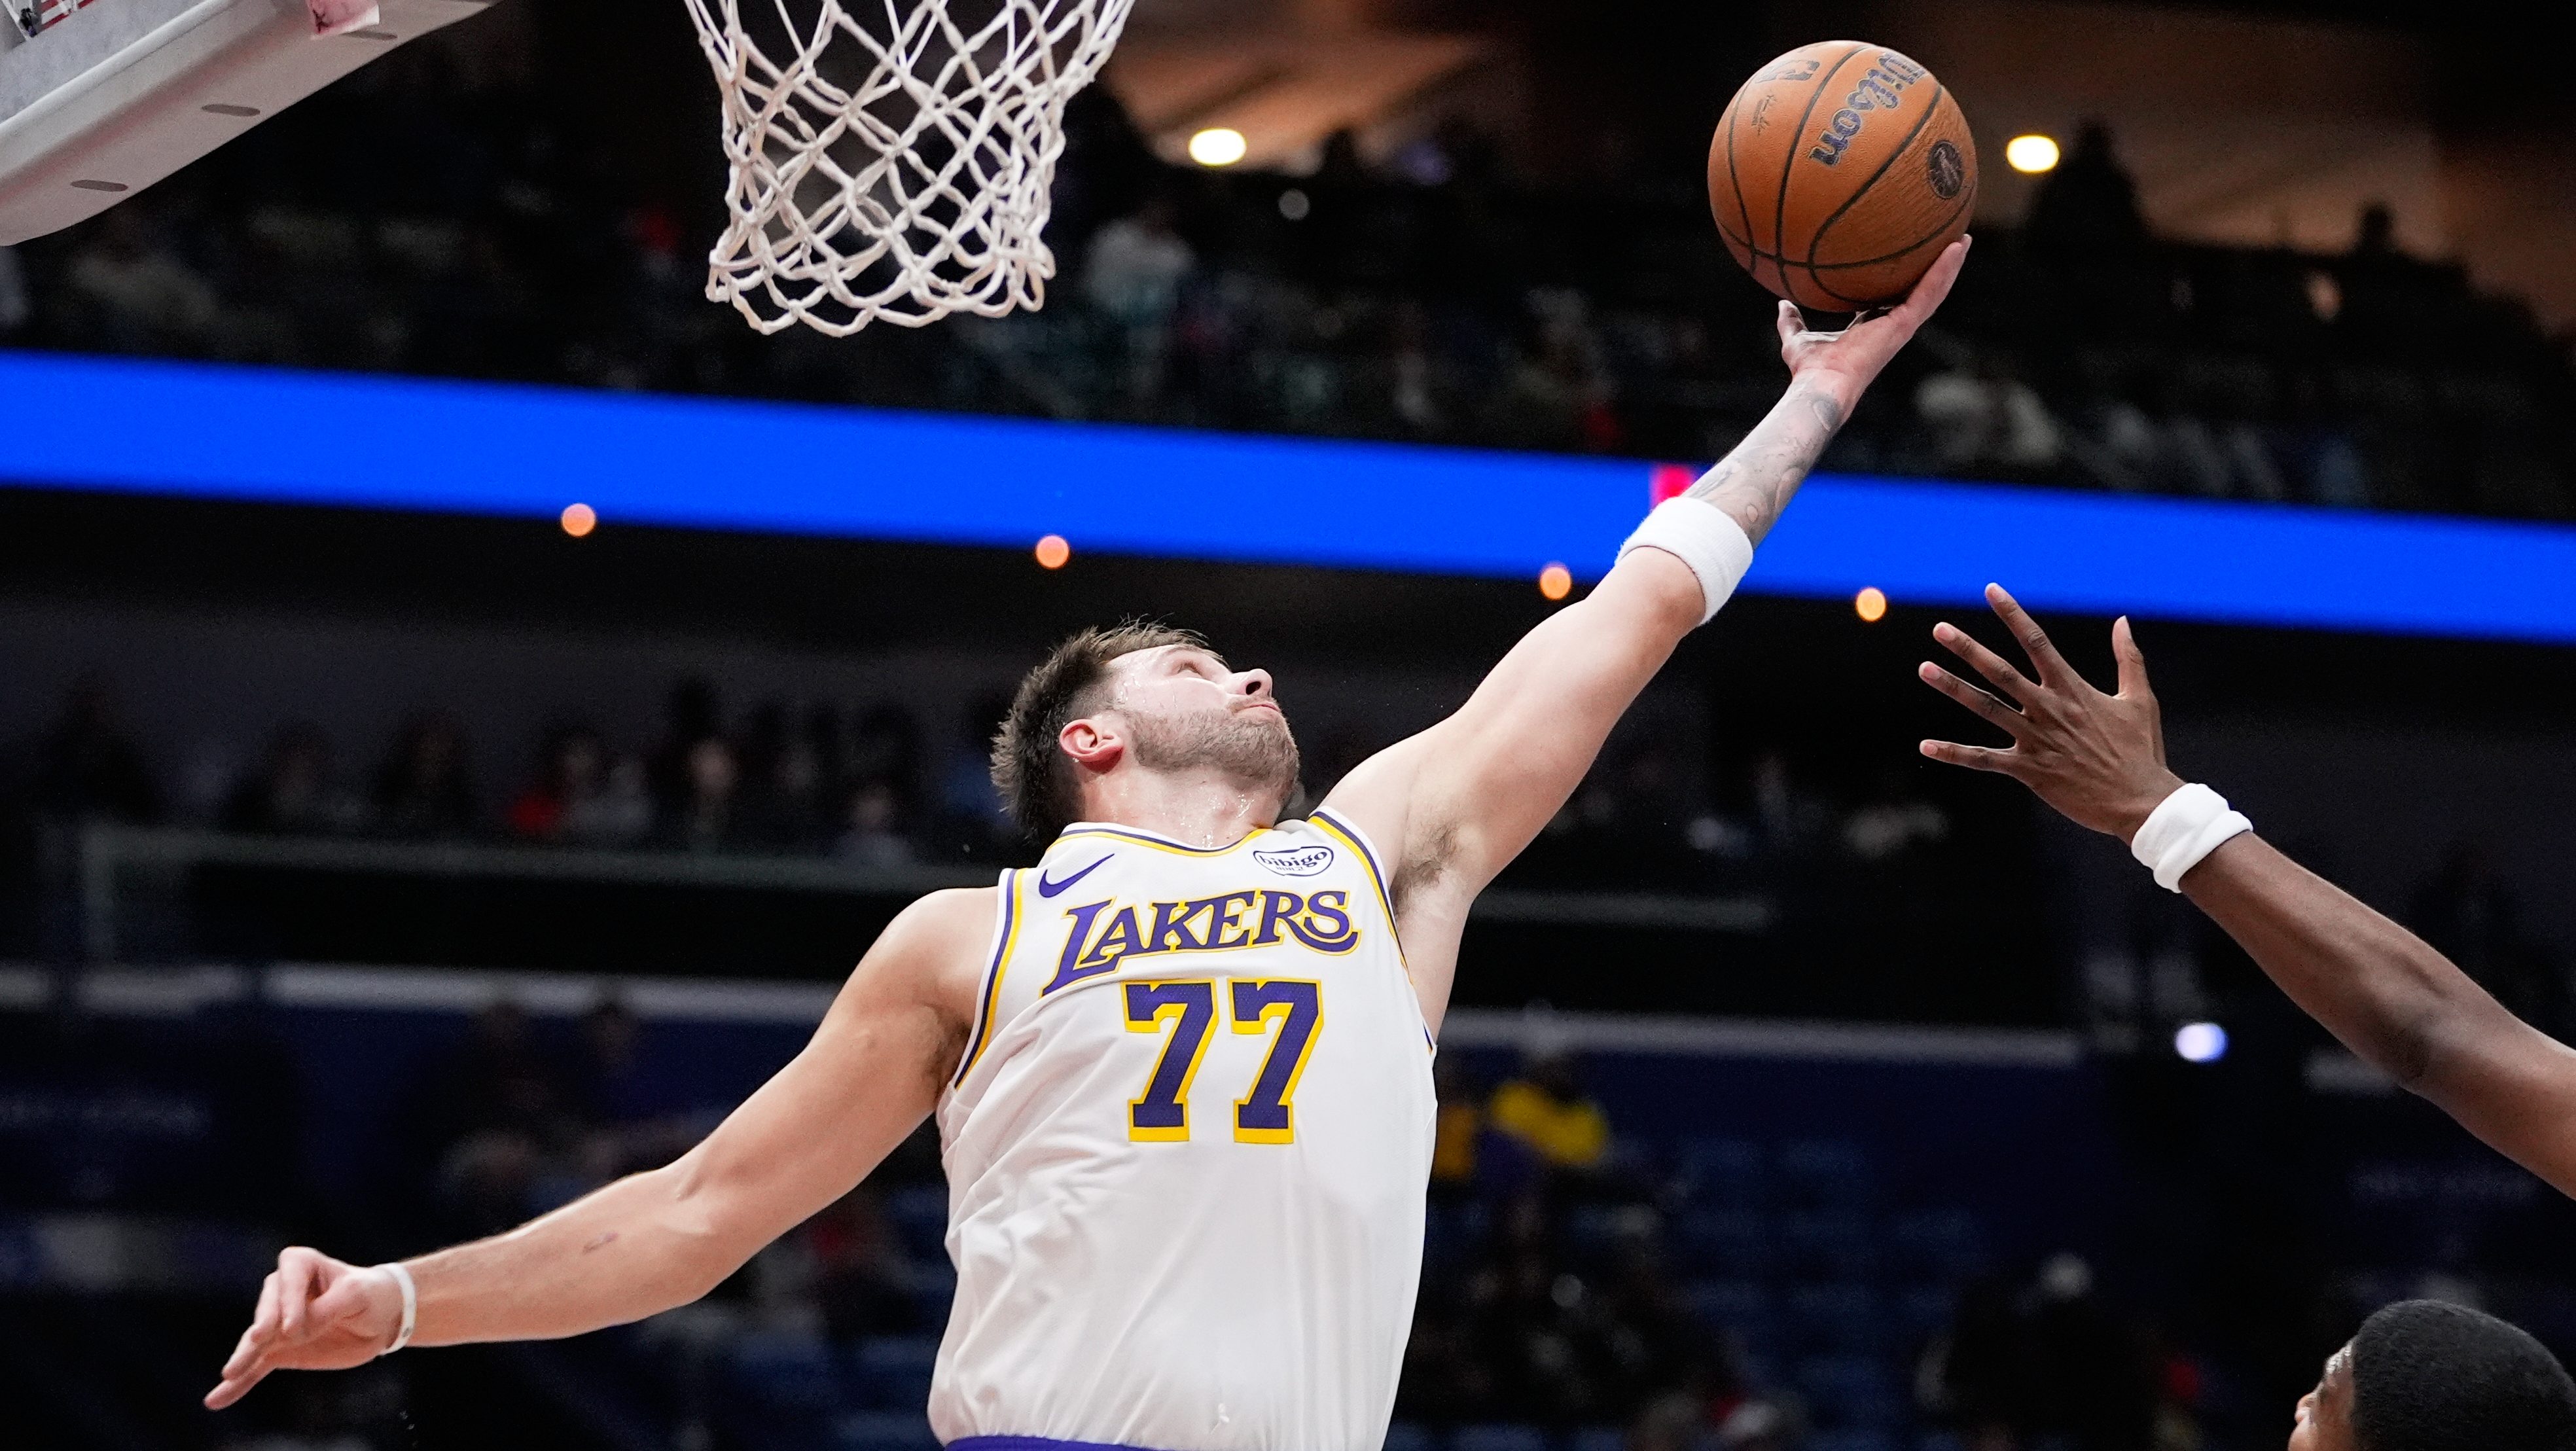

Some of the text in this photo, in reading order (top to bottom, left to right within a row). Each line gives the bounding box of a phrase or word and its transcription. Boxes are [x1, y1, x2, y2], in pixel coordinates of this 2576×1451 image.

[1809, 52, 1925, 166] Wilson
[1259, 851, 1327, 868] bibigo
[1041, 889, 1361, 997] LAKERS
[1121, 978, 1324, 1143] 77
